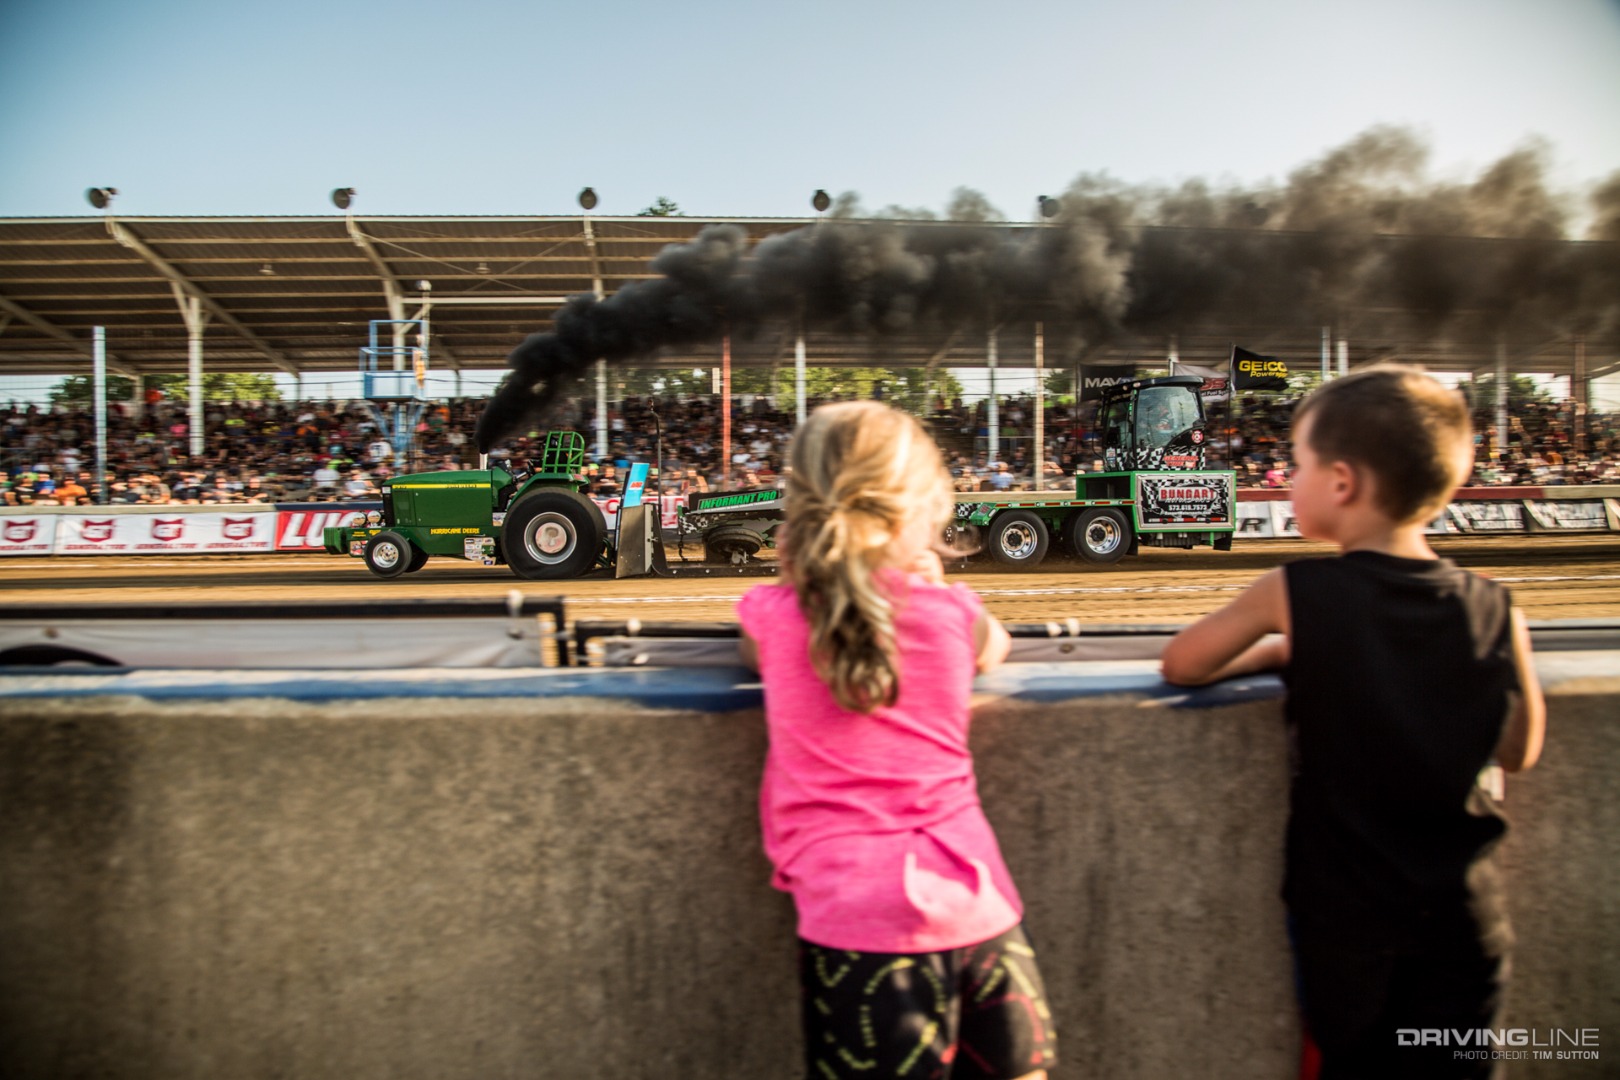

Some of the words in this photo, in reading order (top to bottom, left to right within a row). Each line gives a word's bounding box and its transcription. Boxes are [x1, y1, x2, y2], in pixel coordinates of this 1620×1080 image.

[1239, 360, 1287, 372] GEICO
[1085, 377, 1136, 389] MAV
[701, 493, 756, 509] INFORMANT
[757, 490, 777, 502] PRO
[1160, 489, 1215, 499] BUNGART
